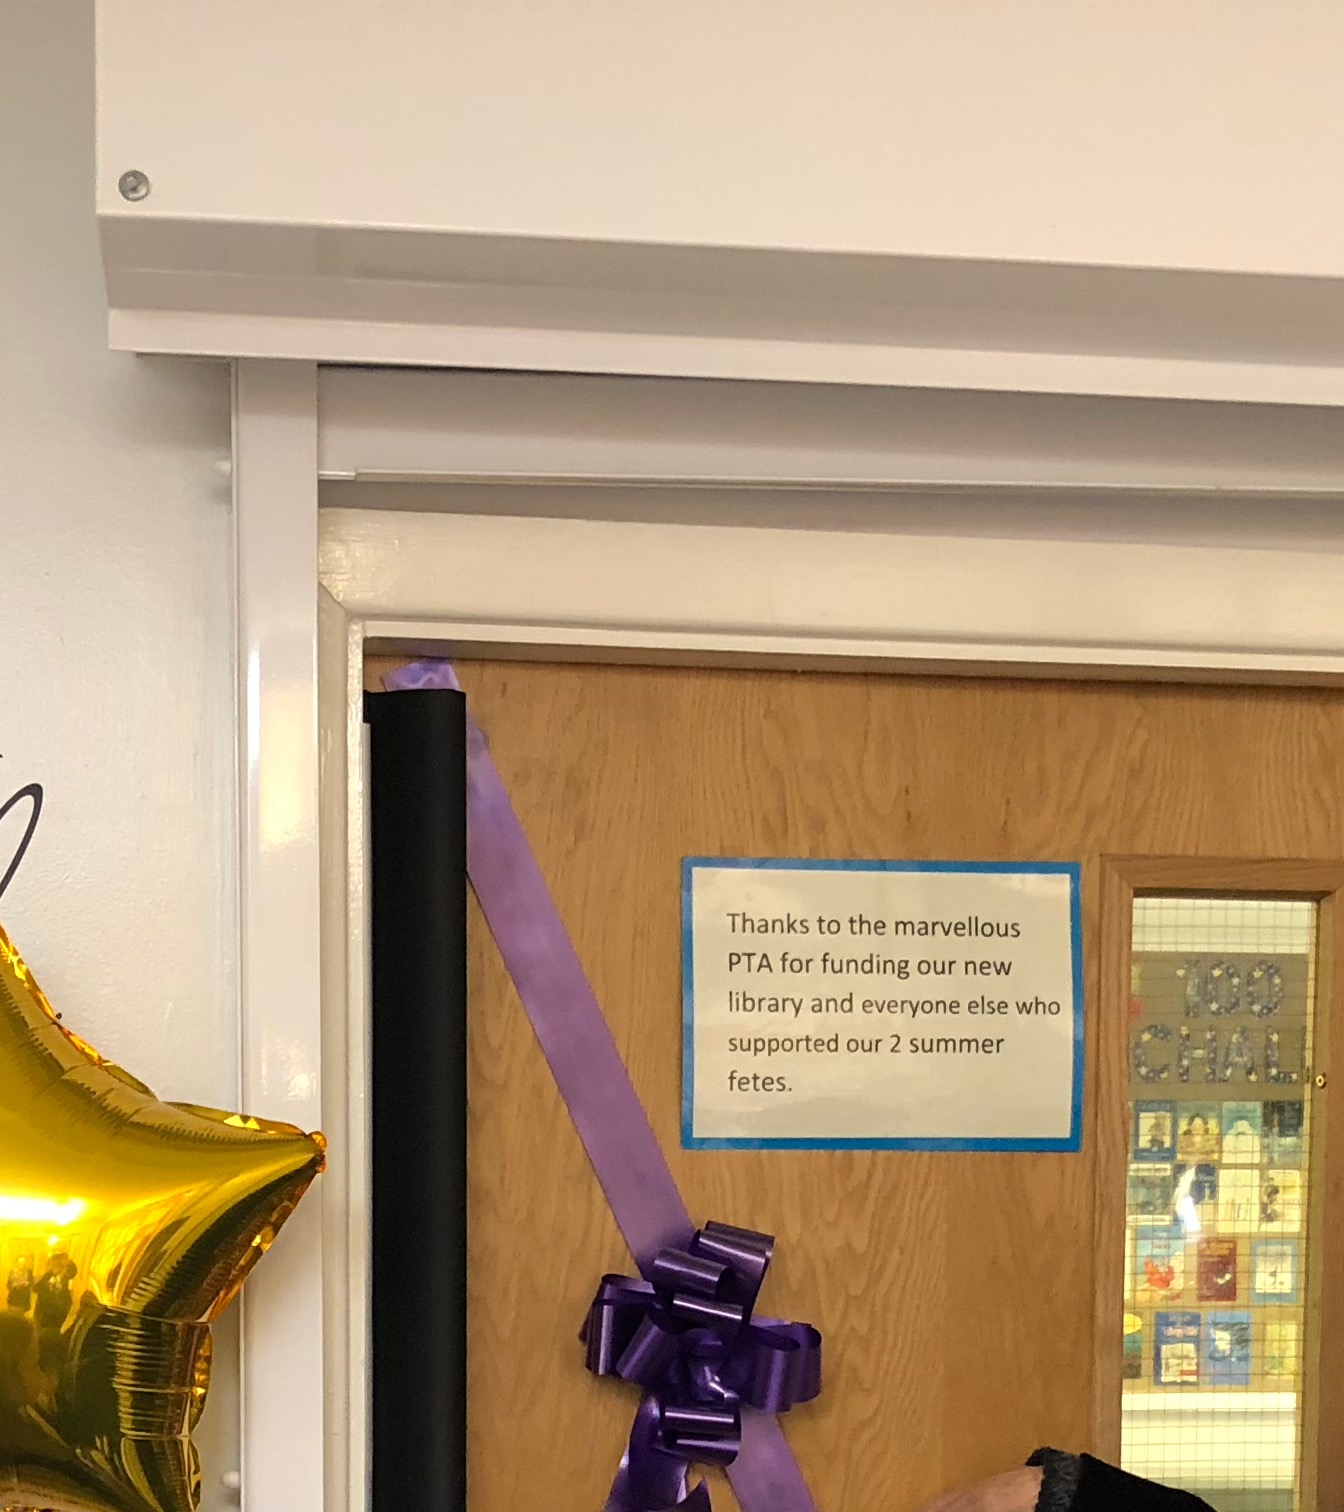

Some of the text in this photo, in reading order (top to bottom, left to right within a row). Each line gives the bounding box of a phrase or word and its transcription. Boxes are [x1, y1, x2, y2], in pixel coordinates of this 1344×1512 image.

[726, 911, 1021, 939] Thanks to the marvellous
[728, 952, 1013, 981] PTA for funding our new
[728, 990, 1061, 1019] library and everyone else who
[728, 1032, 1005, 1057] supported our 2 summer
[727, 1070, 793, 1093] fetes.
